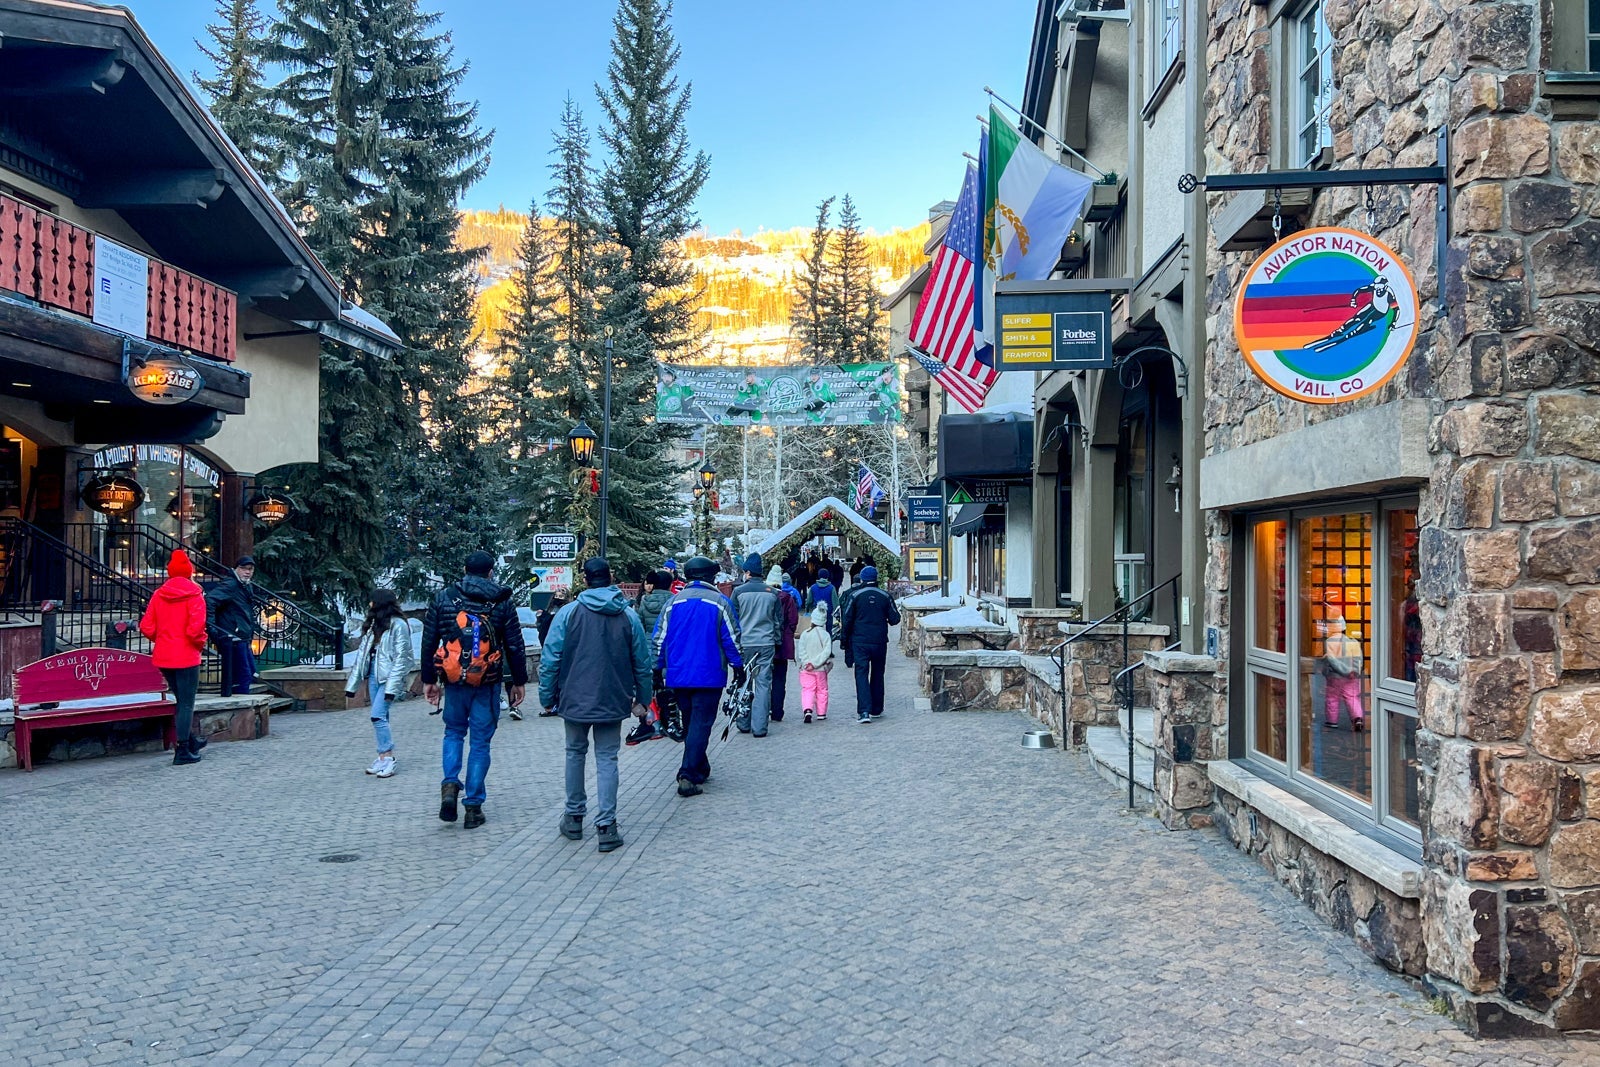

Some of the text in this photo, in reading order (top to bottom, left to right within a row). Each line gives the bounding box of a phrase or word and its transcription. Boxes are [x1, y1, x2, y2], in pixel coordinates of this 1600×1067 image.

[1264, 236, 1389, 280] AVIATOR NATION
[1005, 317, 1032, 325] SLIFER
[1062, 329, 1096, 339] Forbes
[1005, 351, 1048, 359] FRAMPTON
[822, 370, 881, 379] SEMI PRO
[167, 374, 193, 390] SABE
[829, 381, 874, 389] HOCKEY
[1295, 378, 1364, 398] VAIL, CO
[693, 391, 734, 400] DOBSON
[821, 400, 882, 409] ALTITUDE
[149, 445, 182, 466] WHISKEY
[190, 456, 211, 480] SPIRIT
[209, 469, 220, 488] CO.
[975, 487, 1006, 497] STREET
[913, 509, 940, 517] Sotheby's
[540, 543, 570, 551] BRIDGE
[45, 654, 137, 671] KEMO SABE
